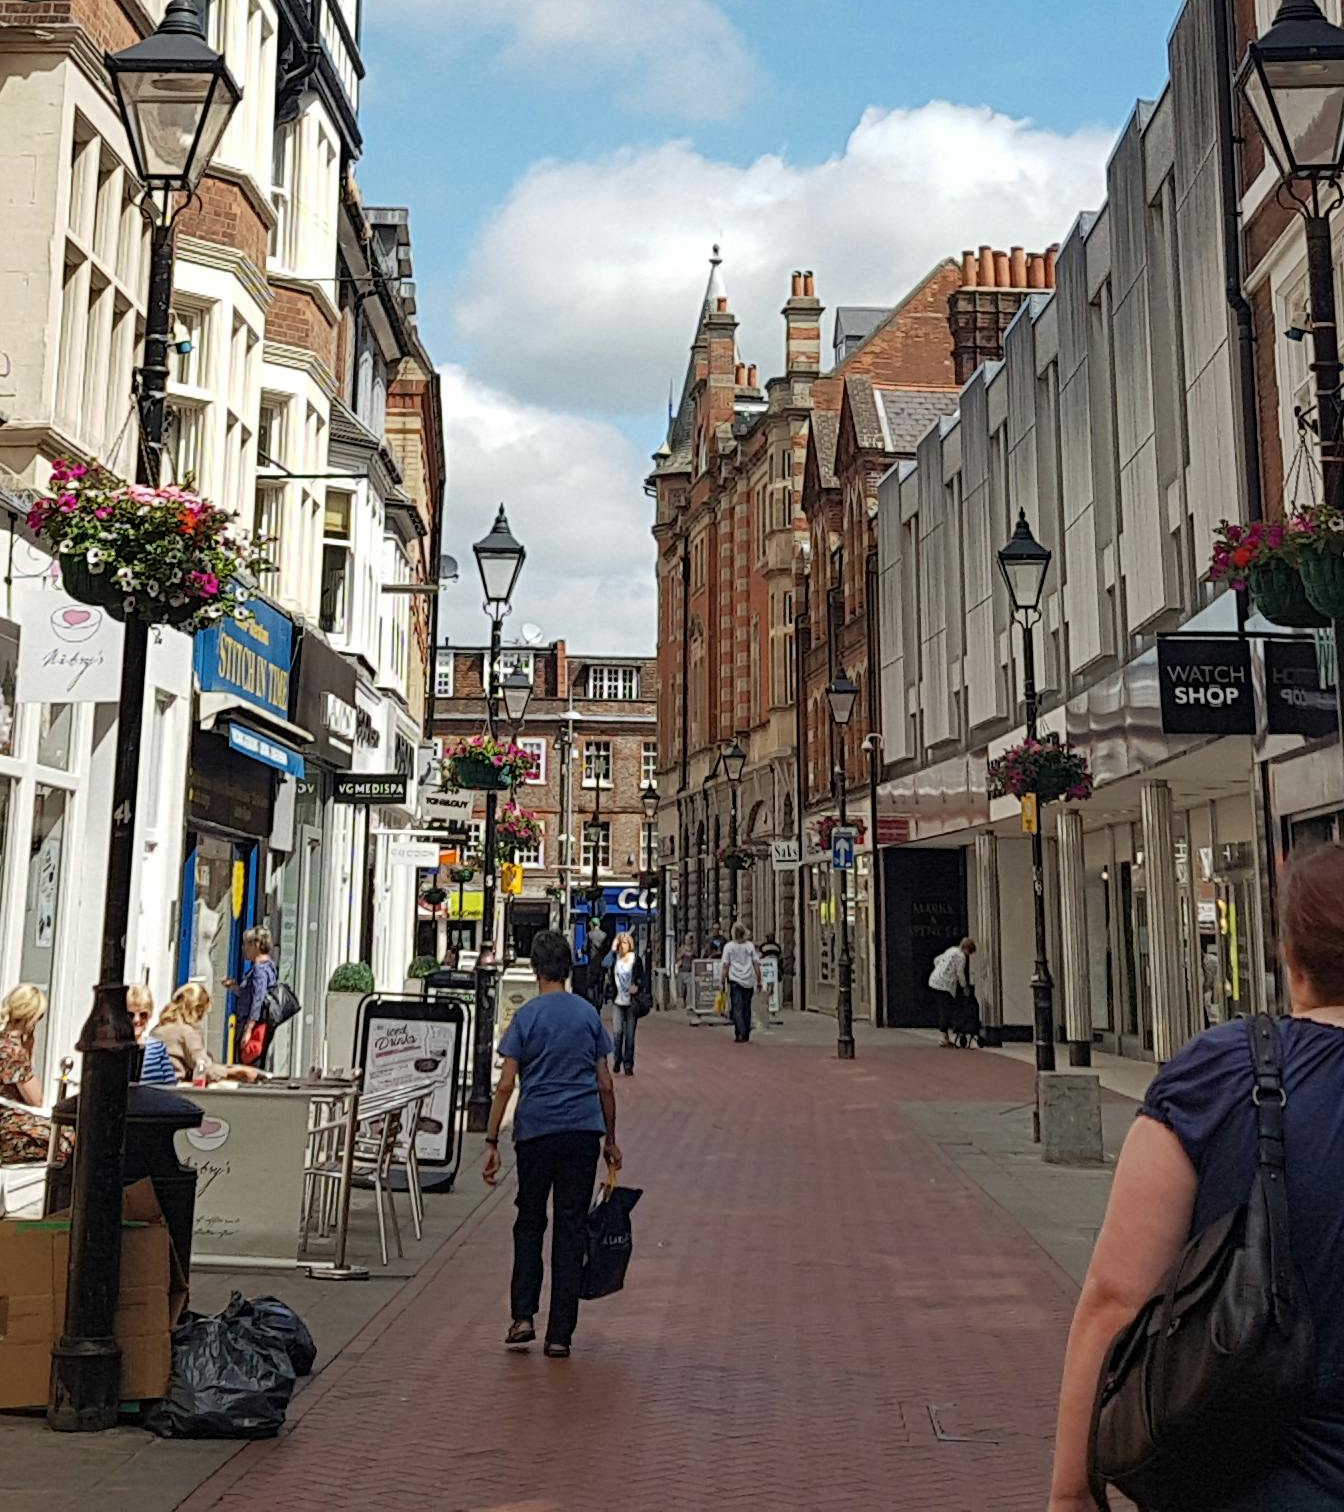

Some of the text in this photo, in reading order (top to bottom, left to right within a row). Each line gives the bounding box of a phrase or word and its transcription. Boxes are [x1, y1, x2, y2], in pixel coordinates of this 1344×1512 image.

[217, 632, 289, 712] STITCH IN TIME
[1166, 664, 1246, 684] WATCH
[1174, 685, 1239, 707] SHOP
[774, 842, 798, 859] Saks
